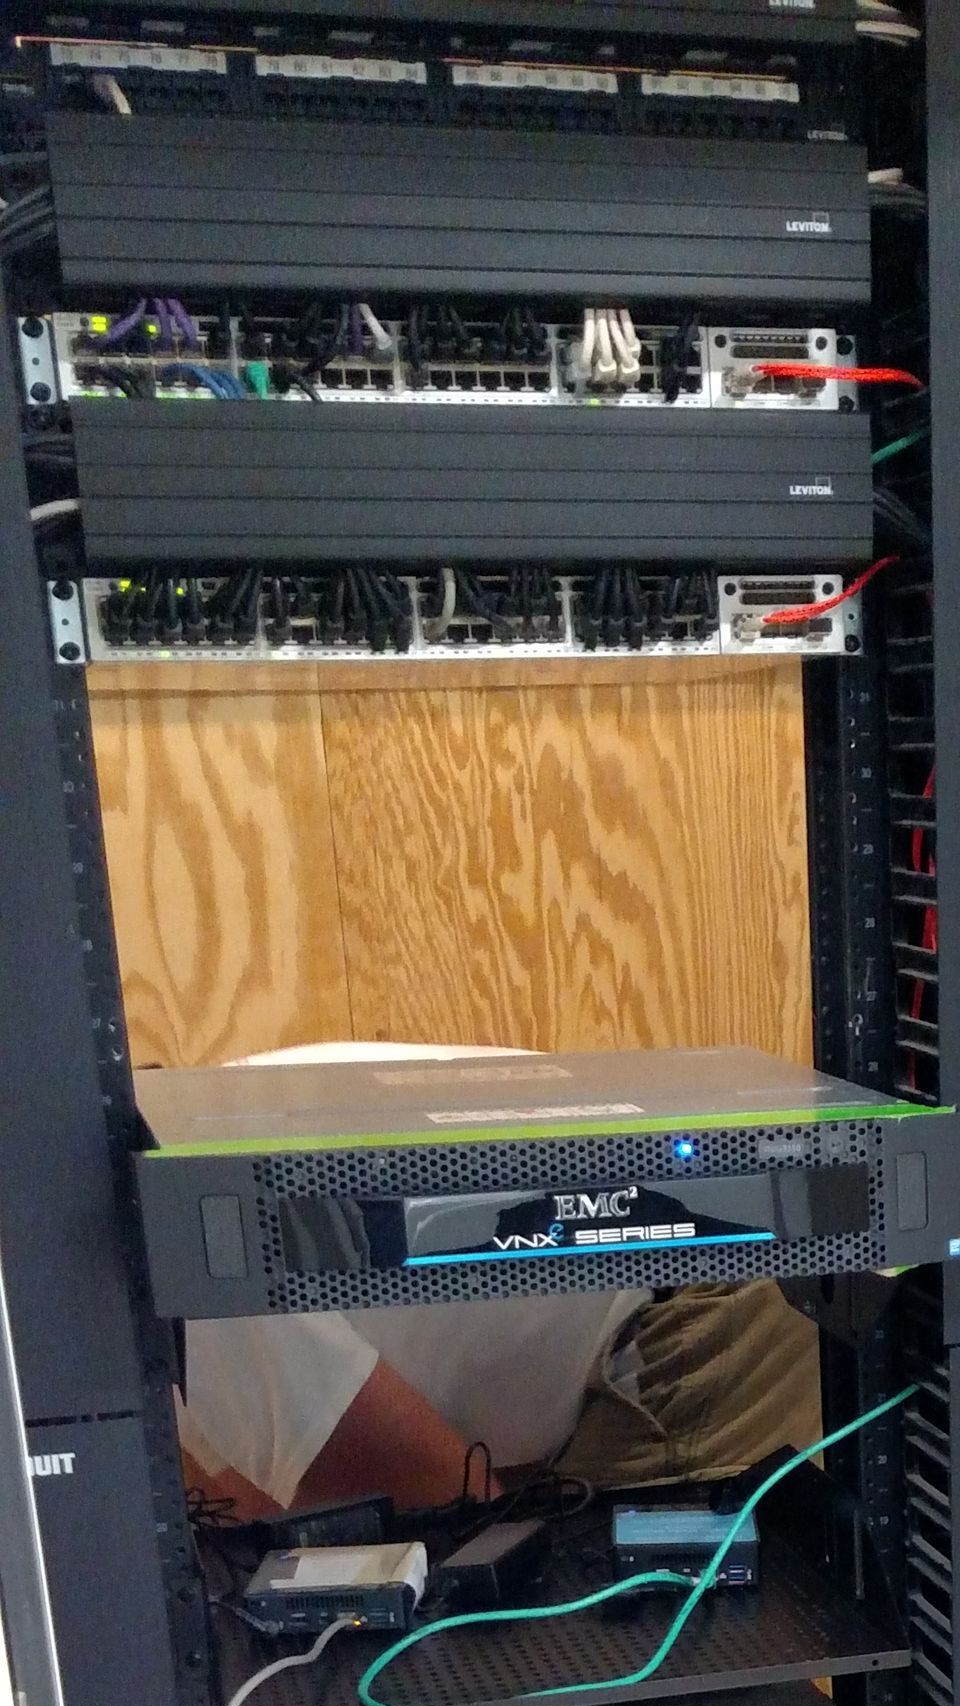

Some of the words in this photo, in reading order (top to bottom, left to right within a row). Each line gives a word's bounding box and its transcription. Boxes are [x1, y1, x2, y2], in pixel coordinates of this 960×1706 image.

[786, 221, 830, 232] LEVITON
[789, 485, 832, 495] LEVITON
[575, 1222, 696, 1245] SERIES
